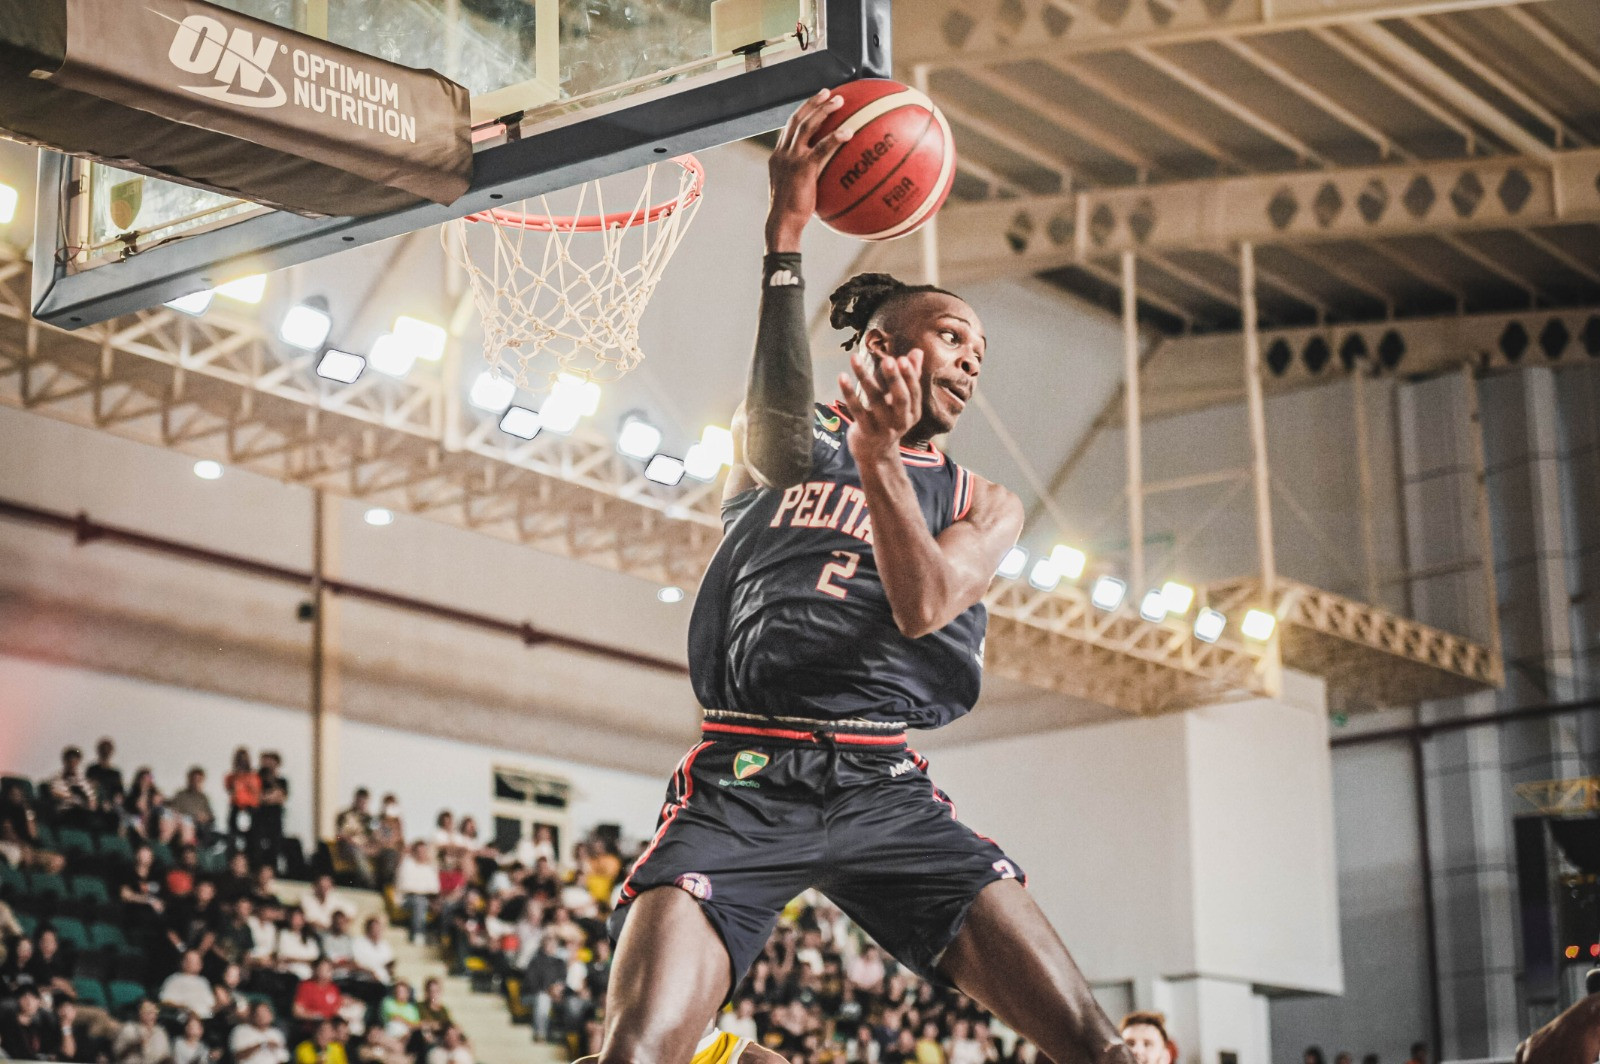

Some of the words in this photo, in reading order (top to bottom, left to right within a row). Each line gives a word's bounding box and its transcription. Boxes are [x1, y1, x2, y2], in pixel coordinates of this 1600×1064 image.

[168, 15, 279, 93] ON
[292, 49, 399, 110] OPTIMUM
[293, 78, 416, 143] NUTRITION
[840, 133, 898, 190] molten
[882, 176, 915, 208] FIBA
[815, 550, 860, 600] 2
